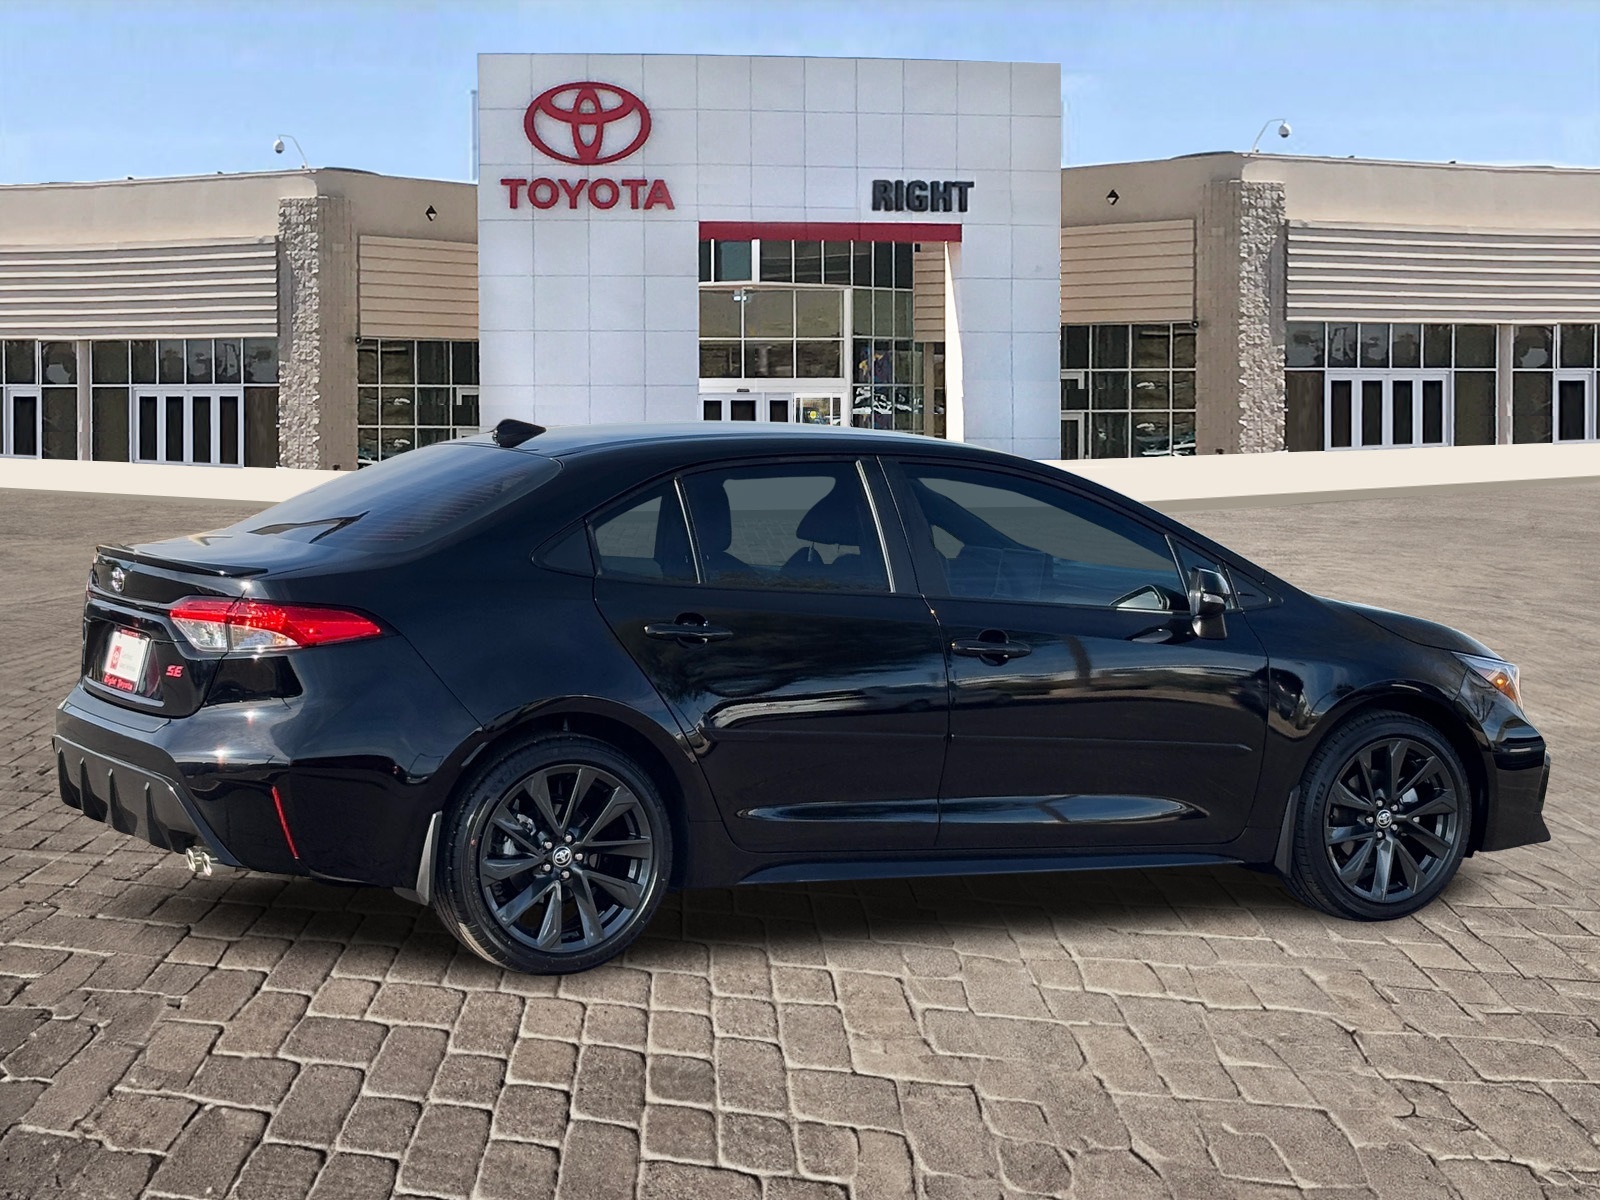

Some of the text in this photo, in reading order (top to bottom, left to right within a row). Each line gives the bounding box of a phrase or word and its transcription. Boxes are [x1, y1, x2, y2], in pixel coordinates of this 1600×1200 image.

[500, 178, 675, 210] TOYOTA
[872, 180, 974, 212] RIGHT
[166, 665, 184, 678] SE
